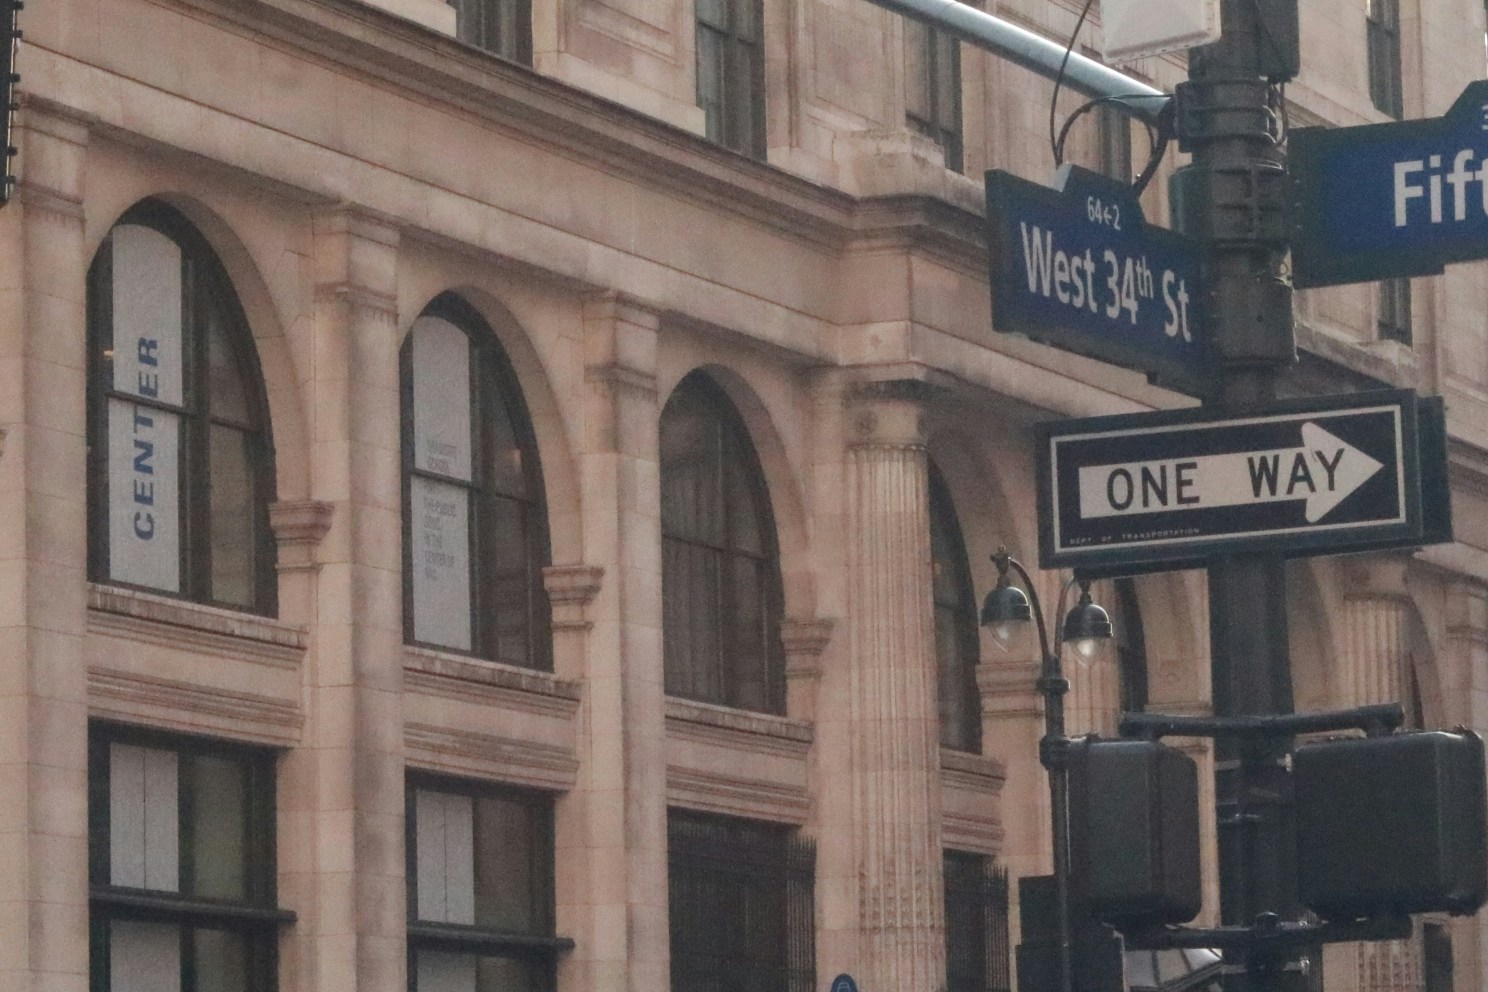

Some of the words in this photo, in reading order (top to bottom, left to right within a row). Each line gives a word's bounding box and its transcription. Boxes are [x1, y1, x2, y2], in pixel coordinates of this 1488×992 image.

[1087, 196, 1103, 225] 64
[1113, 205, 1121, 231] 2
[1020, 221, 1098, 313] West
[1104, 249, 1154, 325] 34th
[1162, 269, 1191, 343] St
[133, 336, 158, 540] CENTER
[1106, 461, 1200, 511] ONE
[1246, 448, 1345, 498] WAY
[1122, 528, 1200, 540] TRANSPORTATION
